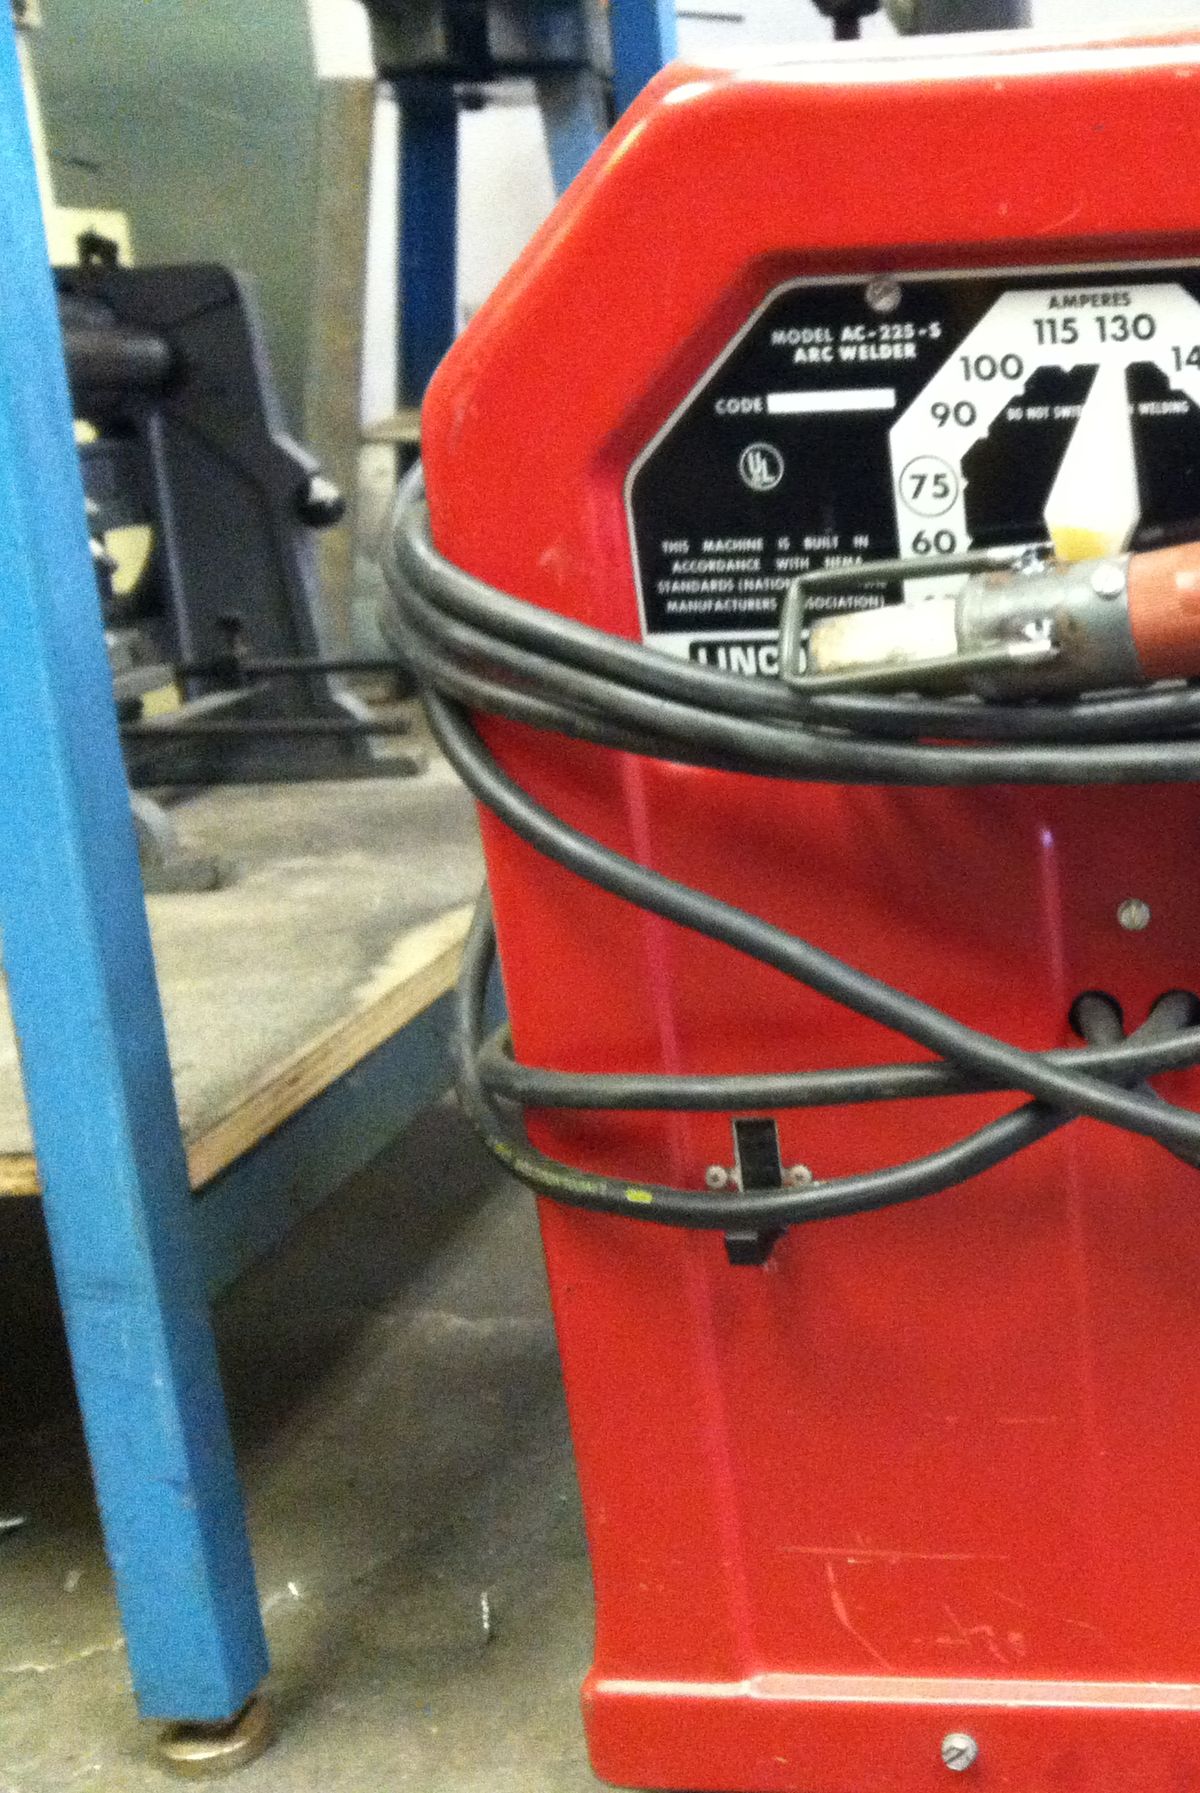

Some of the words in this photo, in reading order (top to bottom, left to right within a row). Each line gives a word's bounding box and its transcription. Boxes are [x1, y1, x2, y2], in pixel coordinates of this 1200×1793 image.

[1048, 292, 1131, 310] AMPERES
[771, 328, 834, 346] MODEL
[1033, 317, 1079, 346] 115
[1096, 313, 1157, 342] 130
[793, 346, 834, 364] ARC
[840, 343, 917, 362] WELDER
[960, 353, 1024, 382] 100
[714, 397, 764, 415] CODE
[931, 401, 977, 428] 90
[909, 474, 950, 500] 75
[662, 540, 690, 554] THIS
[702, 538, 764, 552] MACHINE
[777, 537, 791, 550] IS
[803, 535, 839, 549] BUILT
[852, 534, 869, 548] IN
[911, 529, 957, 555] 60
[672, 558, 761, 574] ACCORDANCE
[776, 557, 809, 570] WITH
[657, 579, 735, 594] STANDARDS
[667, 598, 777, 613] MANUFACTURERS
